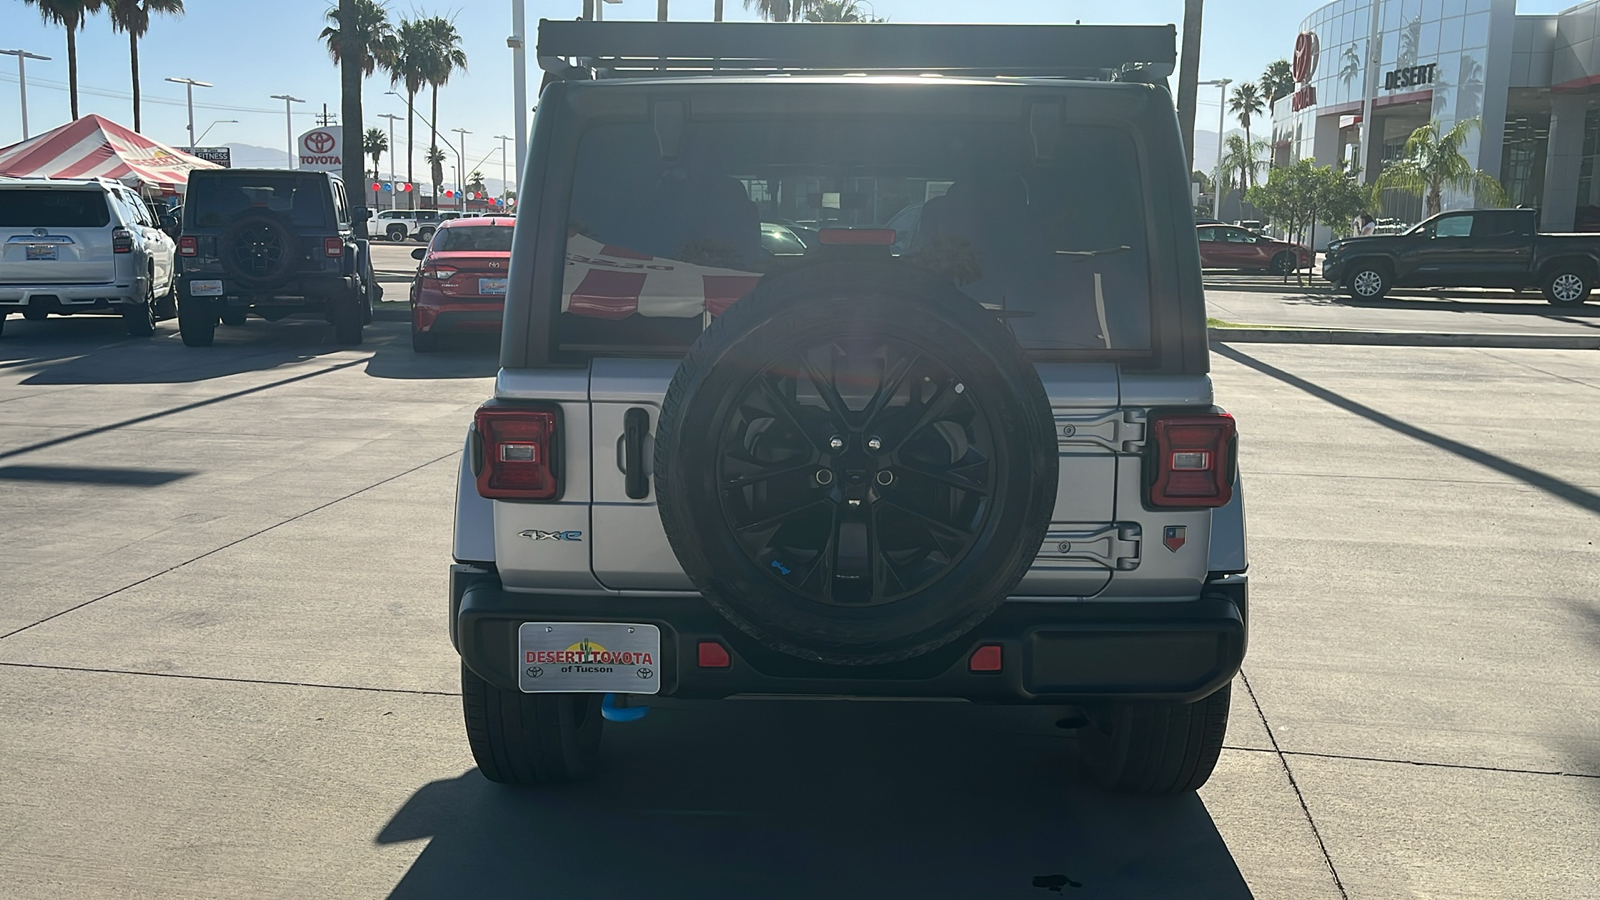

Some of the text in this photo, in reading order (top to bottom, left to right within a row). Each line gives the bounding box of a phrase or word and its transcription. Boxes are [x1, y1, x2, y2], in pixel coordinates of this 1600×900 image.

[1385, 63, 1436, 91] DESERT
[197, 152, 228, 160] FITNESS
[300, 155, 342, 165] TOYOTA
[526, 651, 653, 665] DESERT TOYOTA
[561, 665, 613, 673] of Tucson
